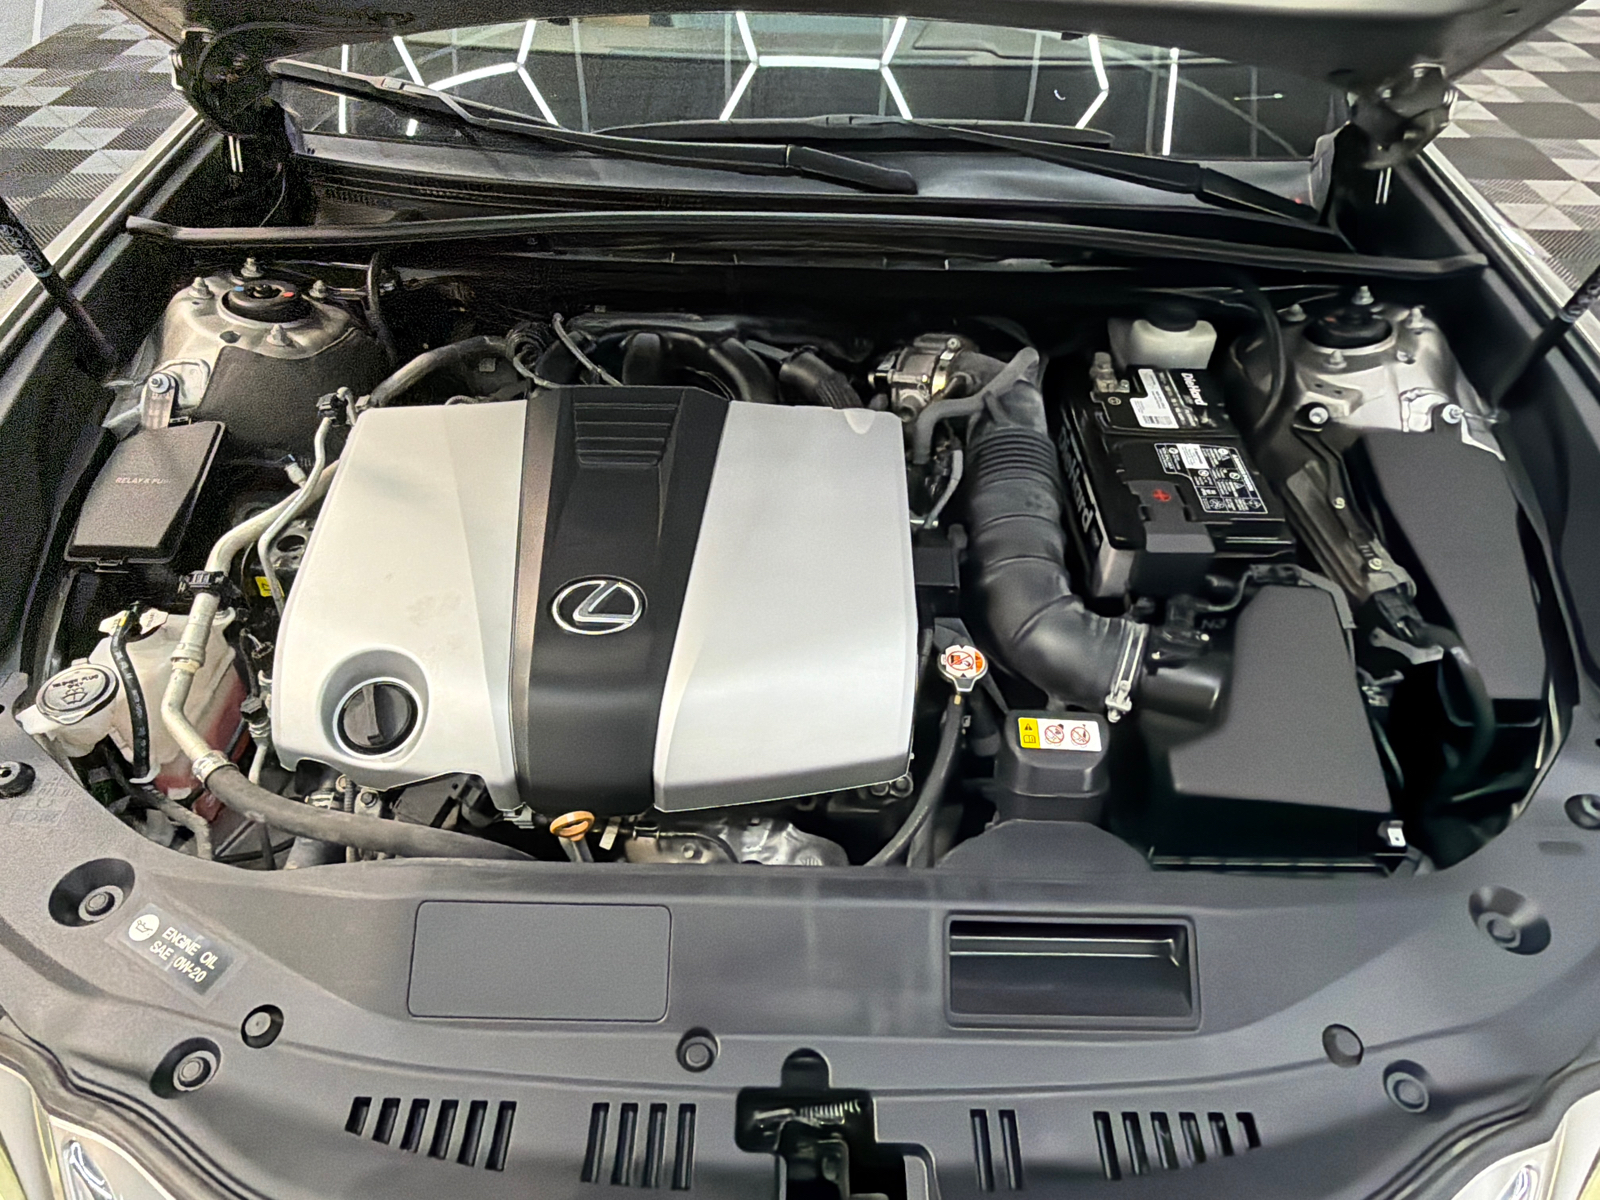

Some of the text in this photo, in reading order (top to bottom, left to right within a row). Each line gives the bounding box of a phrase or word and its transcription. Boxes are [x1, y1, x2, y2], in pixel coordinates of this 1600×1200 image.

[1180, 372, 1208, 406] DieHard
[149, 940, 208, 983] SAE 0W-20
[162, 926, 219, 970] ENGINE OIL
